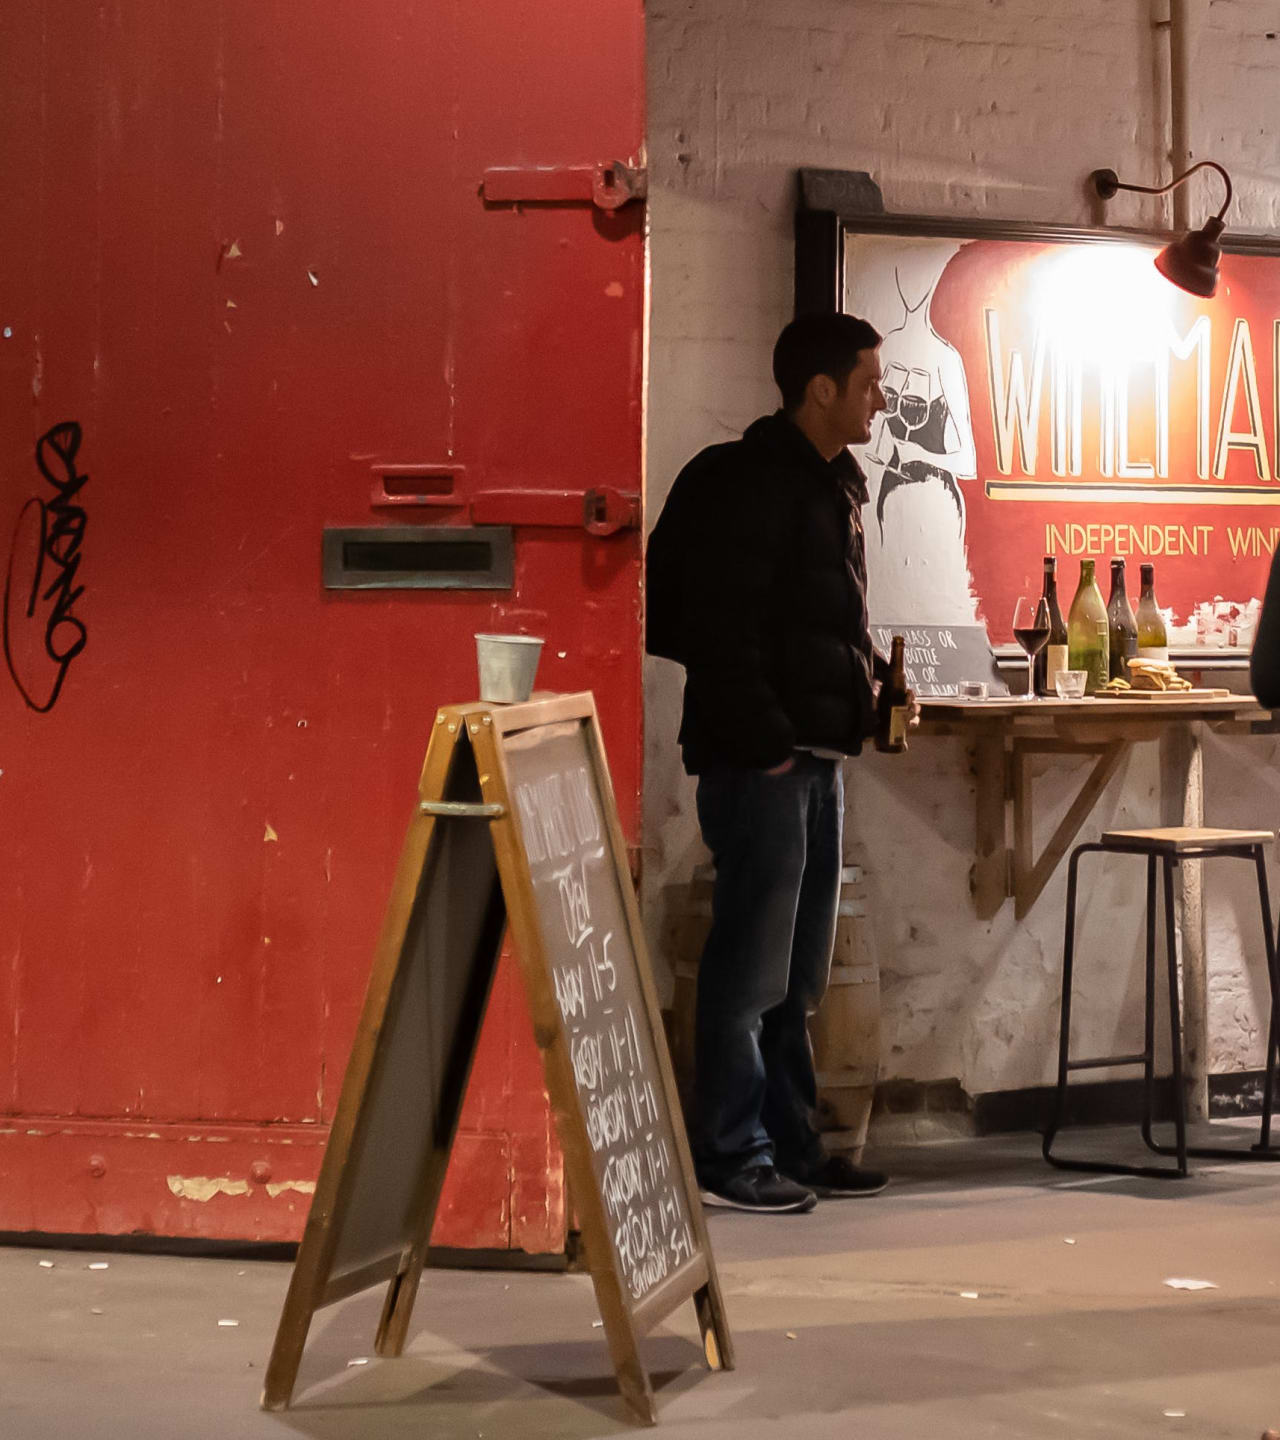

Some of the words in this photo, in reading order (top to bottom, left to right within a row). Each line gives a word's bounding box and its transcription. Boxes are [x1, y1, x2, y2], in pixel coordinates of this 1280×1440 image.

[1045, 523, 1215, 556] INDEPENDENT
[938, 630, 958, 650] OR
[904, 647, 941, 666] BOTTLE
[922, 666, 939, 684] OR
[587, 931, 616, 1002] 11-5
